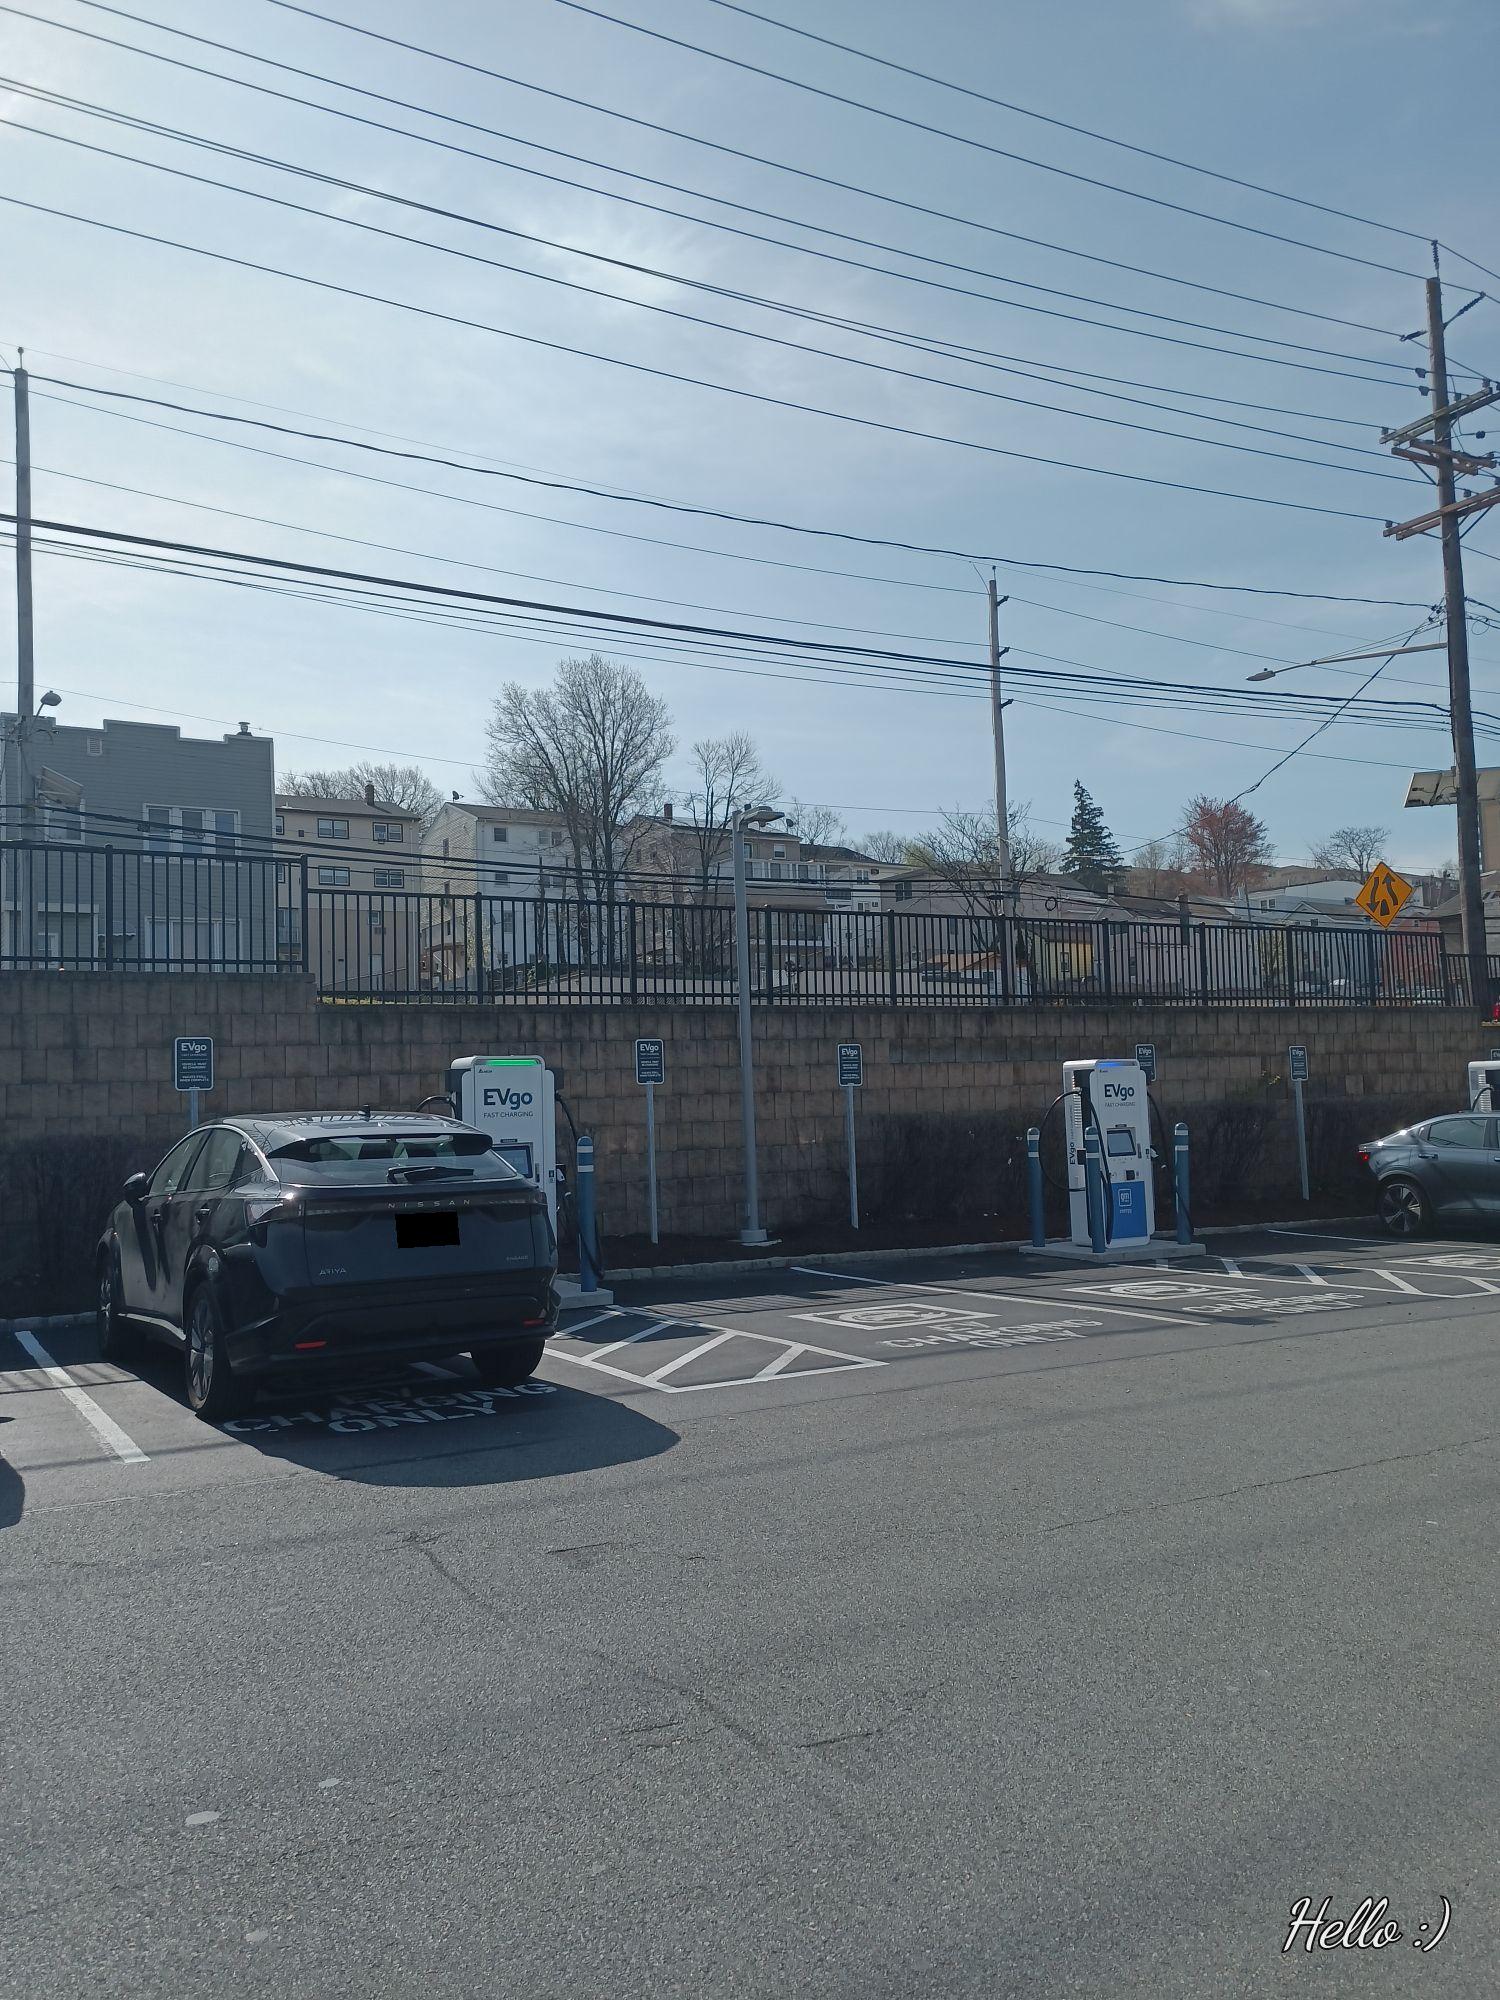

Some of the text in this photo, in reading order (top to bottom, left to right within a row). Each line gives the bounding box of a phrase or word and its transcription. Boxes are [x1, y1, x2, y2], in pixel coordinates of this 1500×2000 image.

[181, 1041, 208, 1053] EVgo
[640, 1043, 660, 1053] EVgo
[483, 1088, 533, 1110] EVgo
[1104, 1084, 1135, 1101] EVgo
[387, 1200, 471, 1209] NISSAN
[880, 1319, 1104, 1348] CHARGING
[969, 1329, 1088, 1349] ONLY
[222, 1382, 558, 1433] CHARGING
[328, 1401, 497, 1433] ONLY
